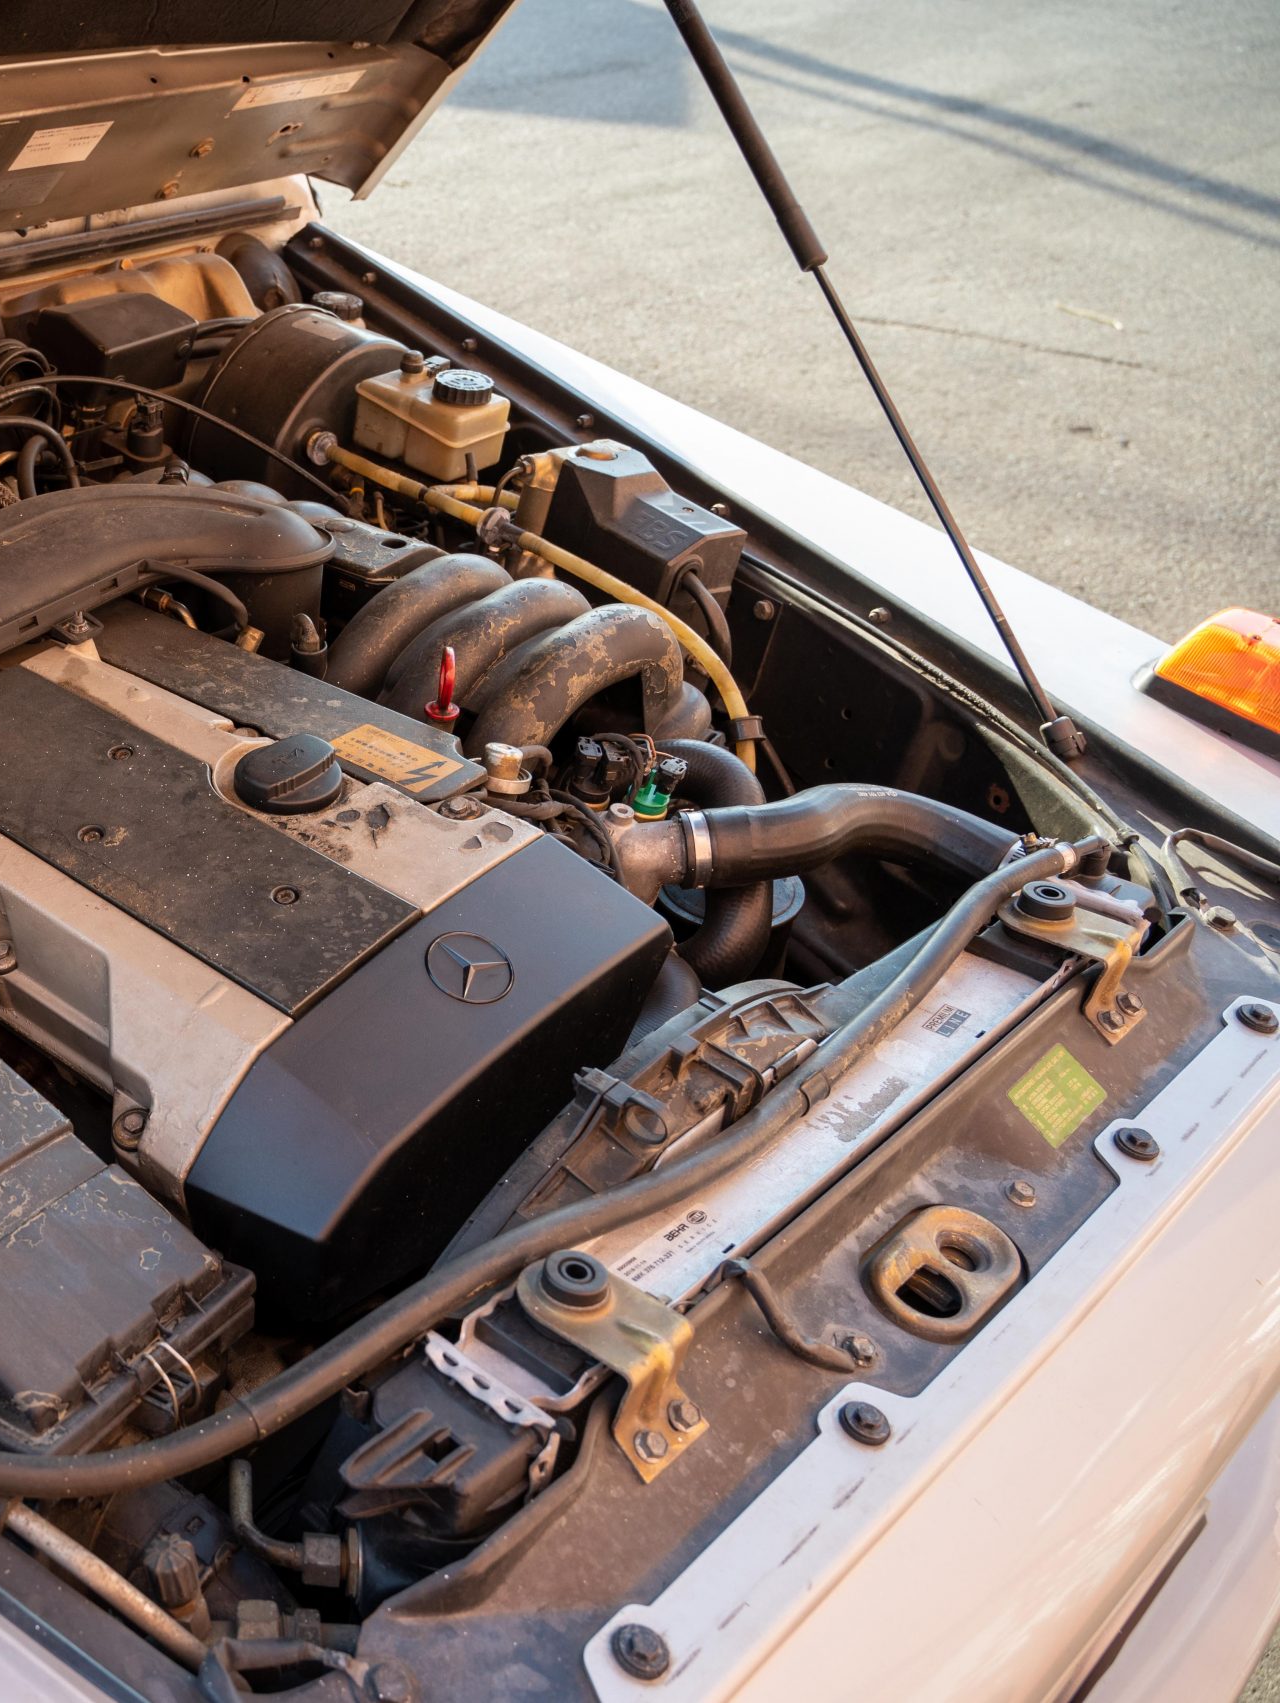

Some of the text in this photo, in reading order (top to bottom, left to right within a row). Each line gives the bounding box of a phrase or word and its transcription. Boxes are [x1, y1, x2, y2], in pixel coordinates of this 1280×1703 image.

[925, 1006, 954, 1030] PREMIUM
[938, 1011, 969, 1037] LINE
[664, 1223, 689, 1242] BEHR
